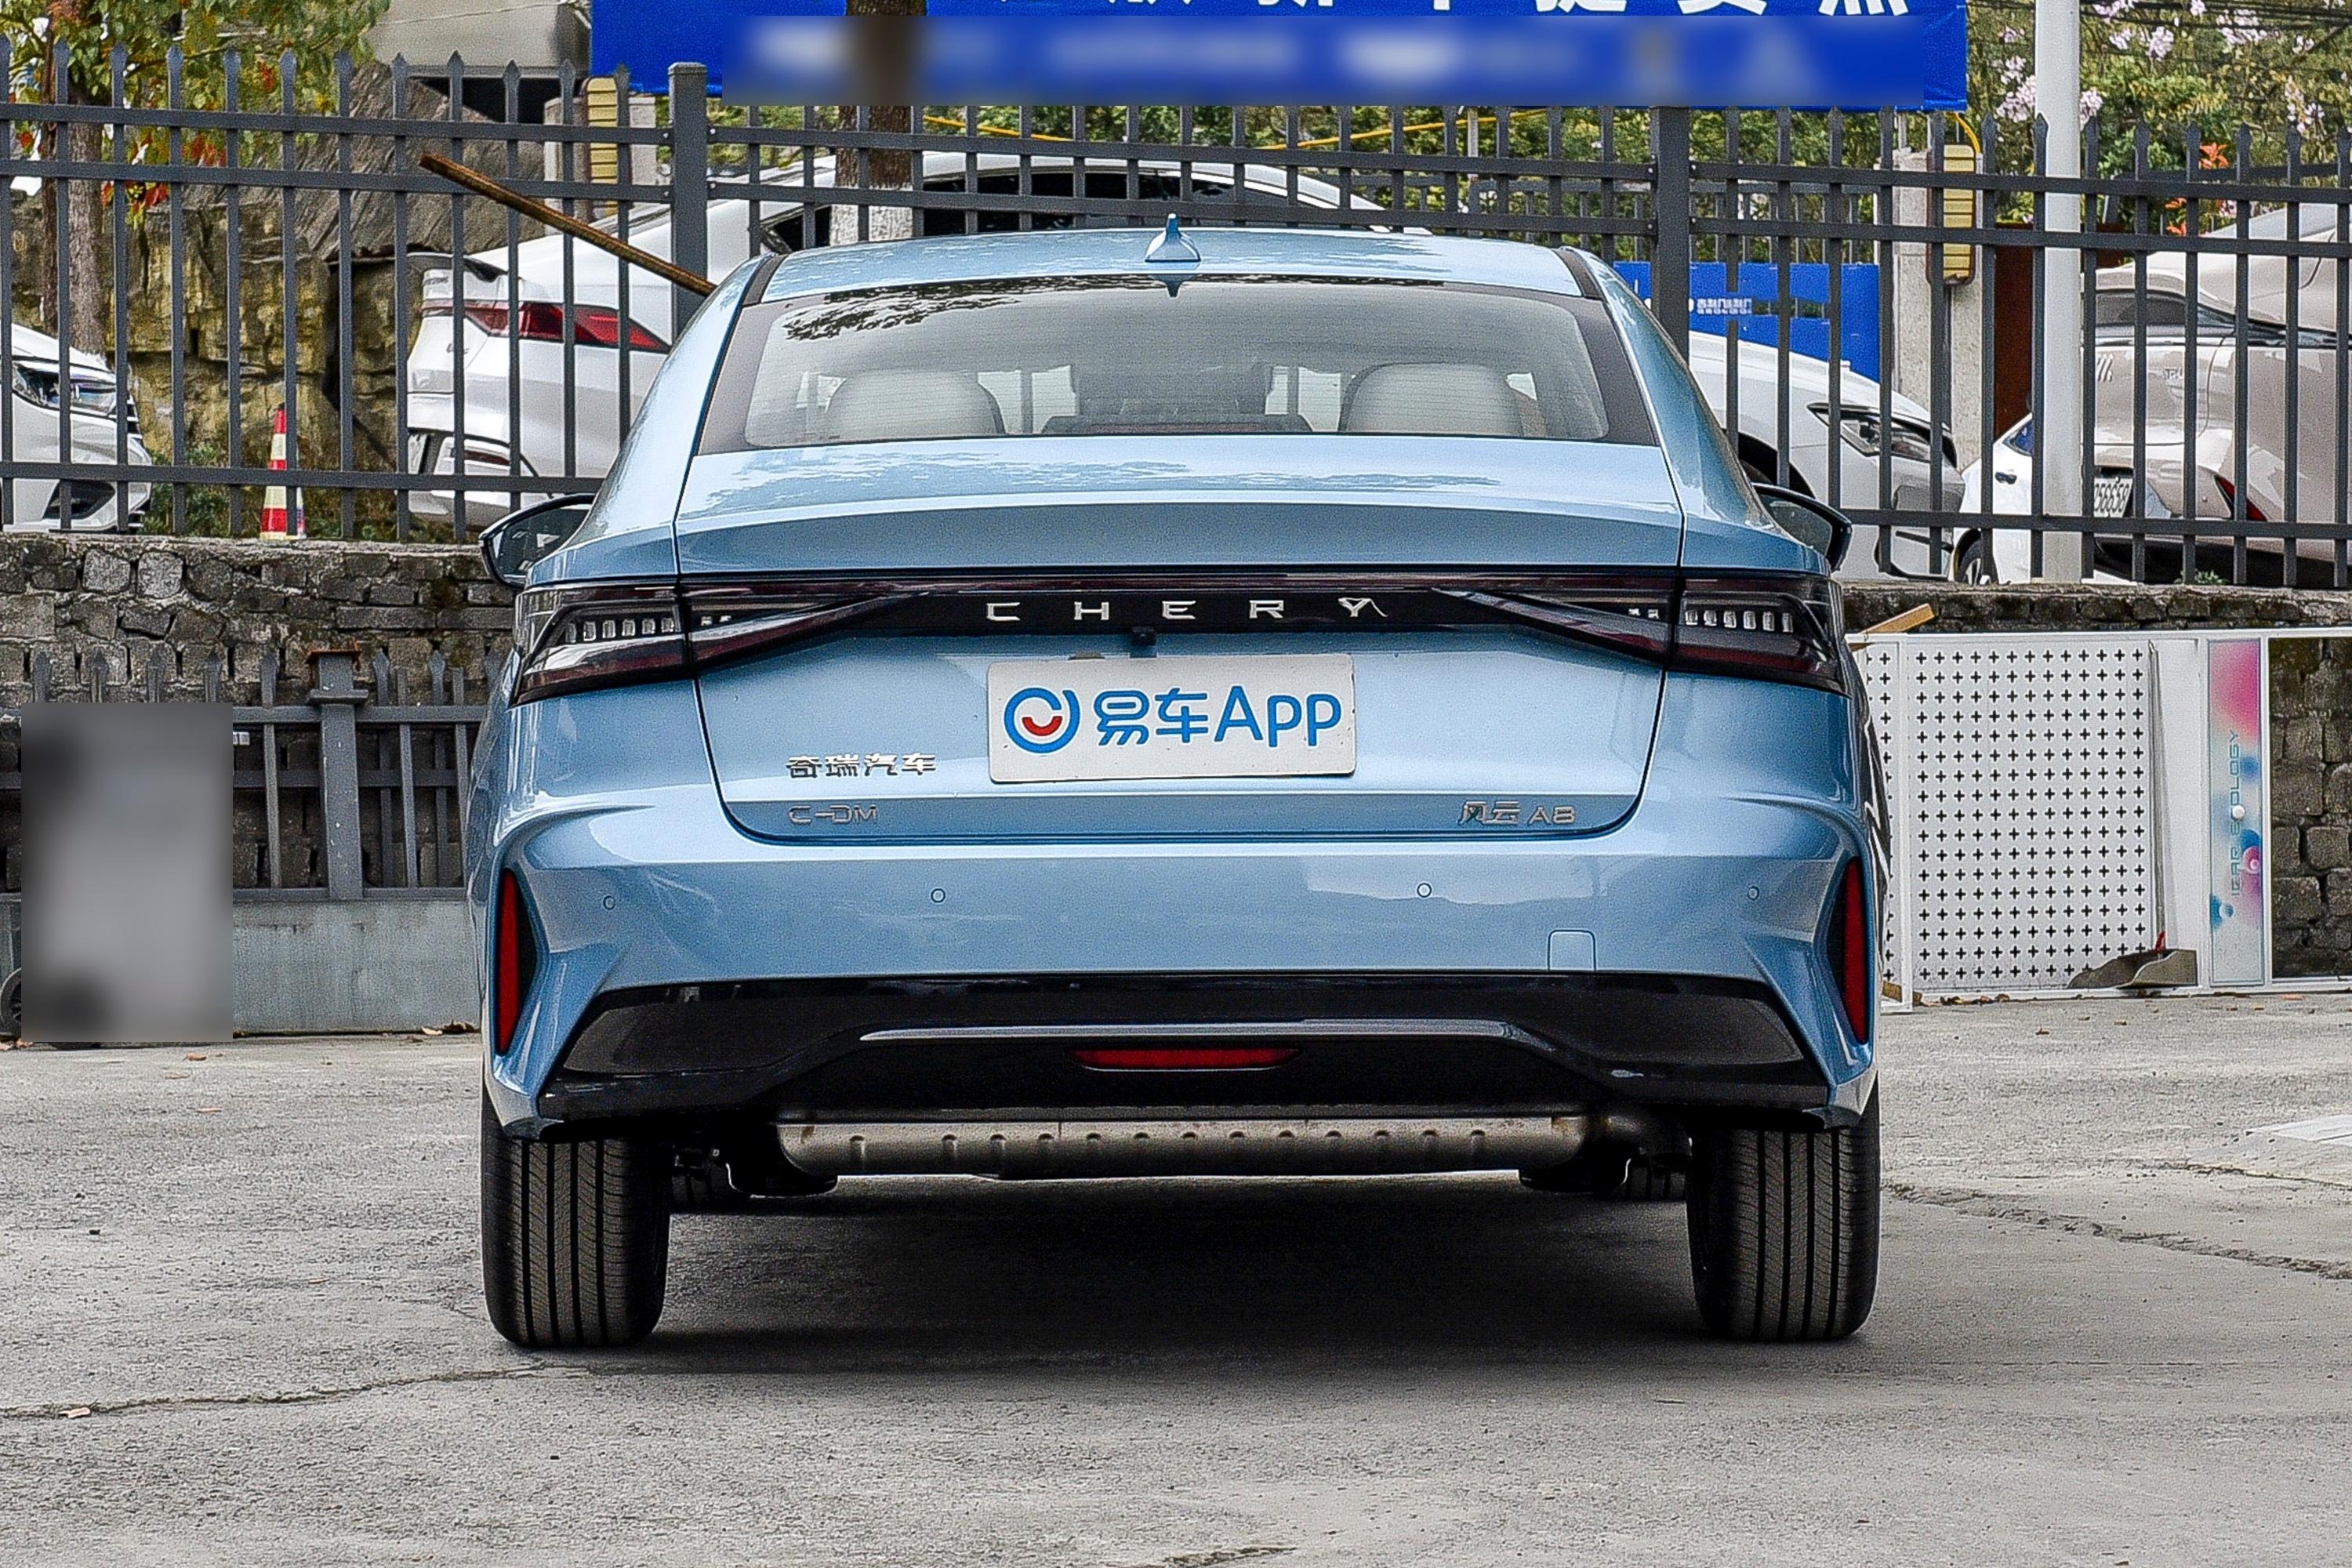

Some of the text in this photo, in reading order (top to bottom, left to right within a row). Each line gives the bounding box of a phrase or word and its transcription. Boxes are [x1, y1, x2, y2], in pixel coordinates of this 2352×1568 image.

[985, 597, 1388, 620] CHERY
[1093, 685, 1341, 748] 易车App
[786, 753, 936, 778] 奇瑞汽车
[789, 804, 879, 825] C-DM
[1457, 800, 1576, 826] 风云 A8
